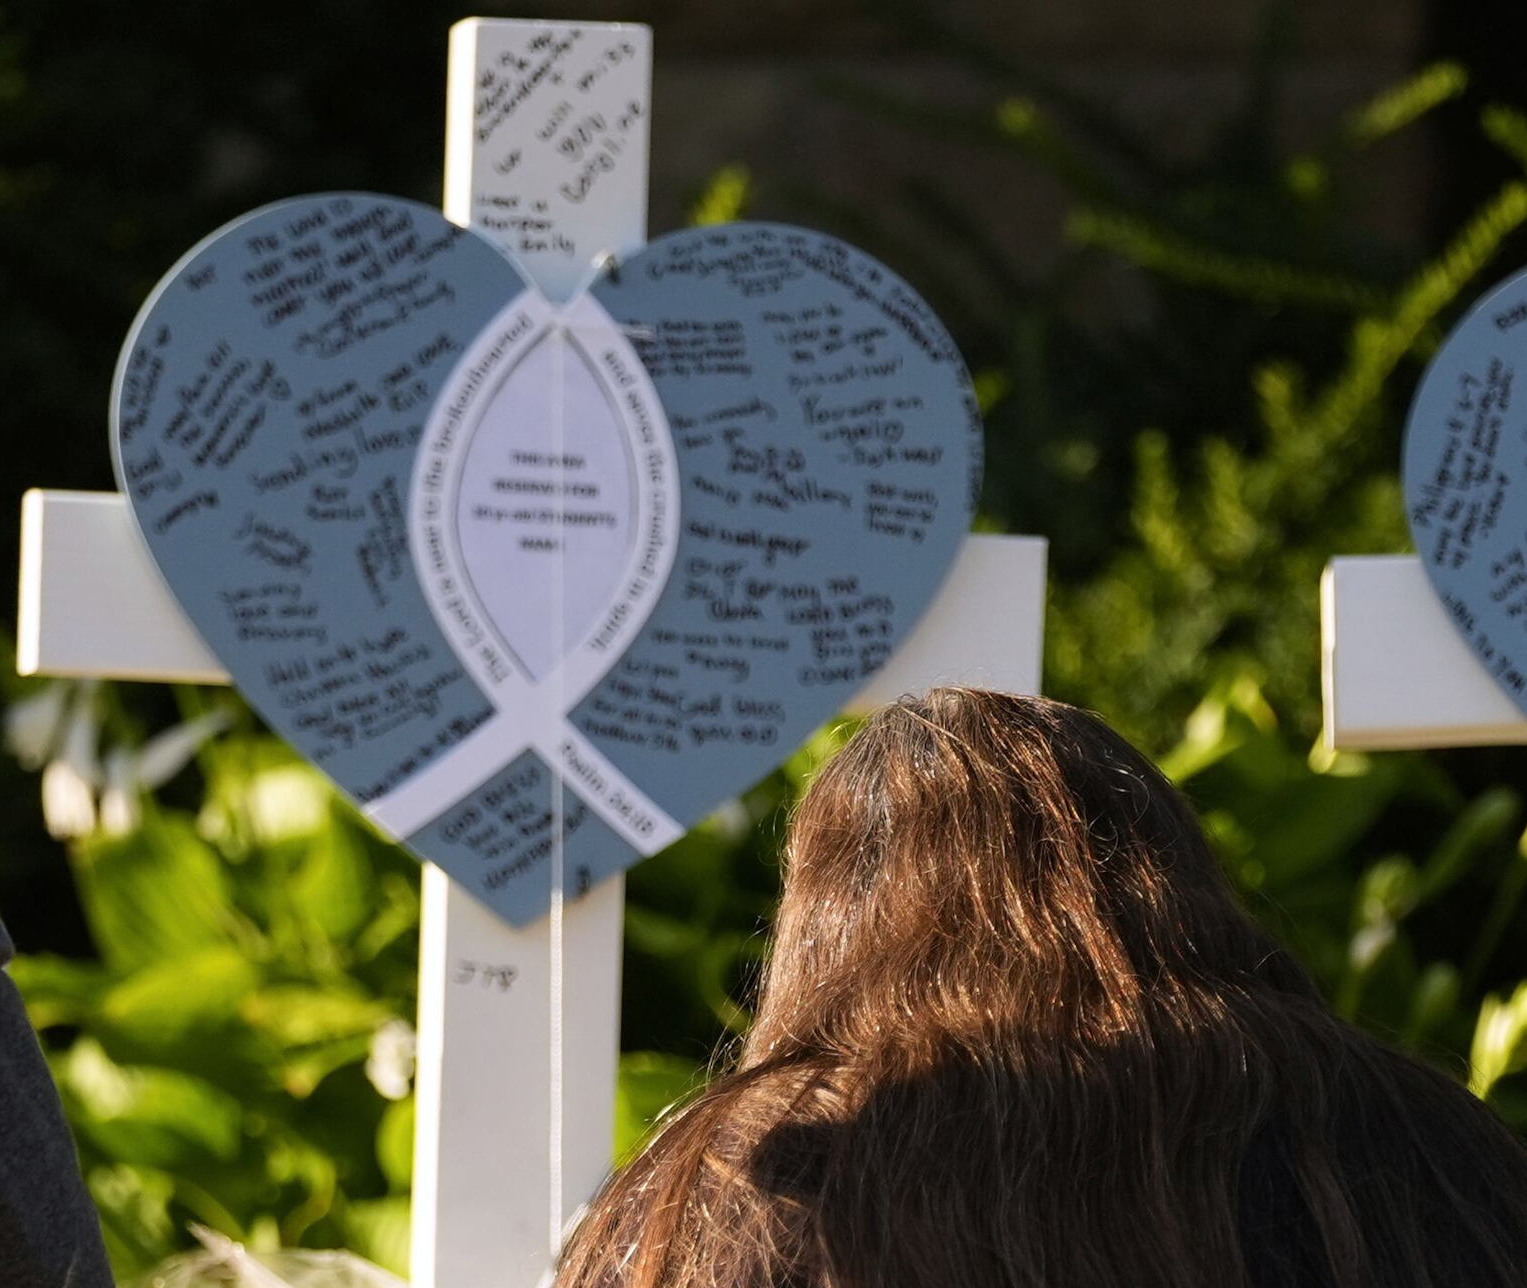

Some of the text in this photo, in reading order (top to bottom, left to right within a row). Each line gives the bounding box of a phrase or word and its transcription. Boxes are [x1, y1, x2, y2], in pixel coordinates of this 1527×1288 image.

[602, 348, 638, 389] and
[626, 390, 657, 442] saves
[644, 450, 667, 483] the
[424, 454, 445, 488] the
[421, 524, 444, 569] near
[518, 536, 563, 550] NAM
[437, 570, 454, 589] is
[444, 595, 485, 648] Lord
[474, 642, 513, 687] The
